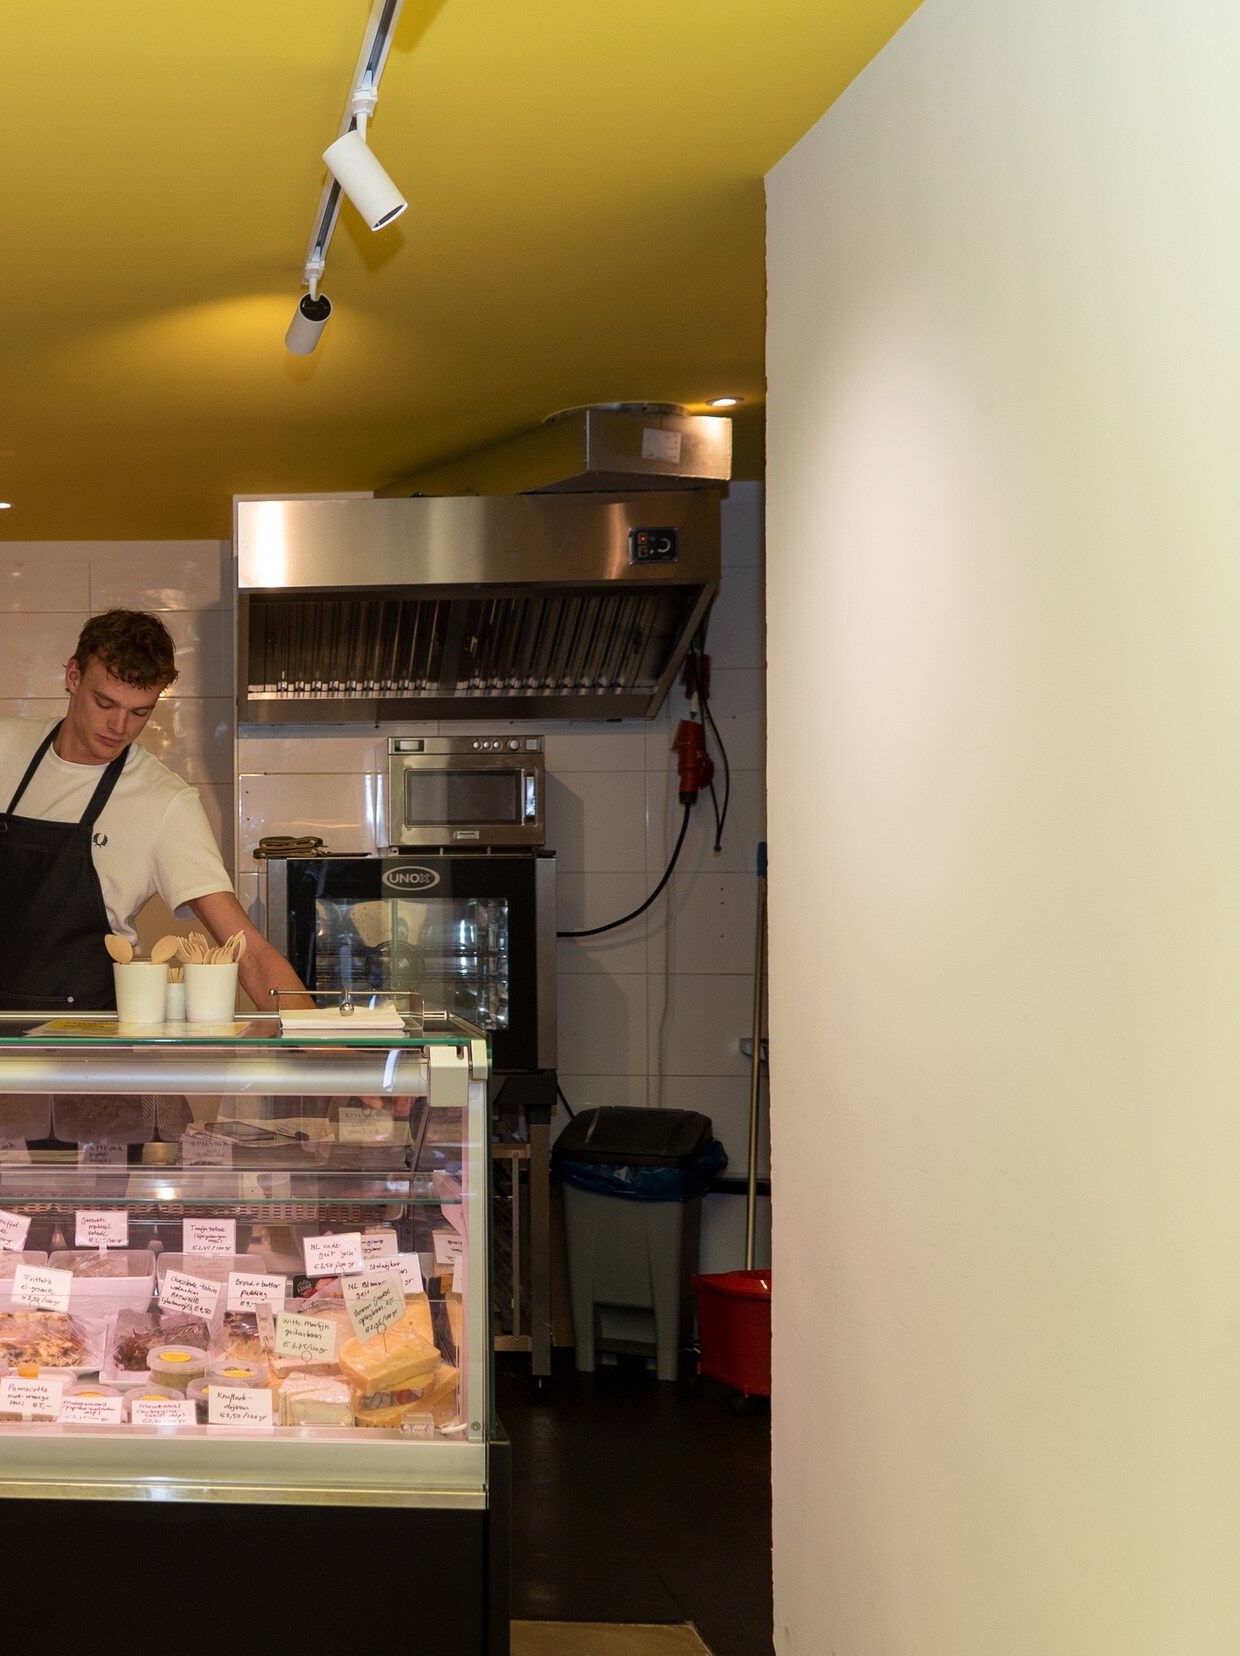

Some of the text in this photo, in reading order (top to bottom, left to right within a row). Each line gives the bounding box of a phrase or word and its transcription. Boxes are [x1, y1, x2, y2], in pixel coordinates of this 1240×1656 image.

[388, 873, 430, 884] UNOX
[310, 1243, 320, 1251] NL
[240, 1289, 267, 1301] pudding
[282, 1318, 303, 1327] Witte
